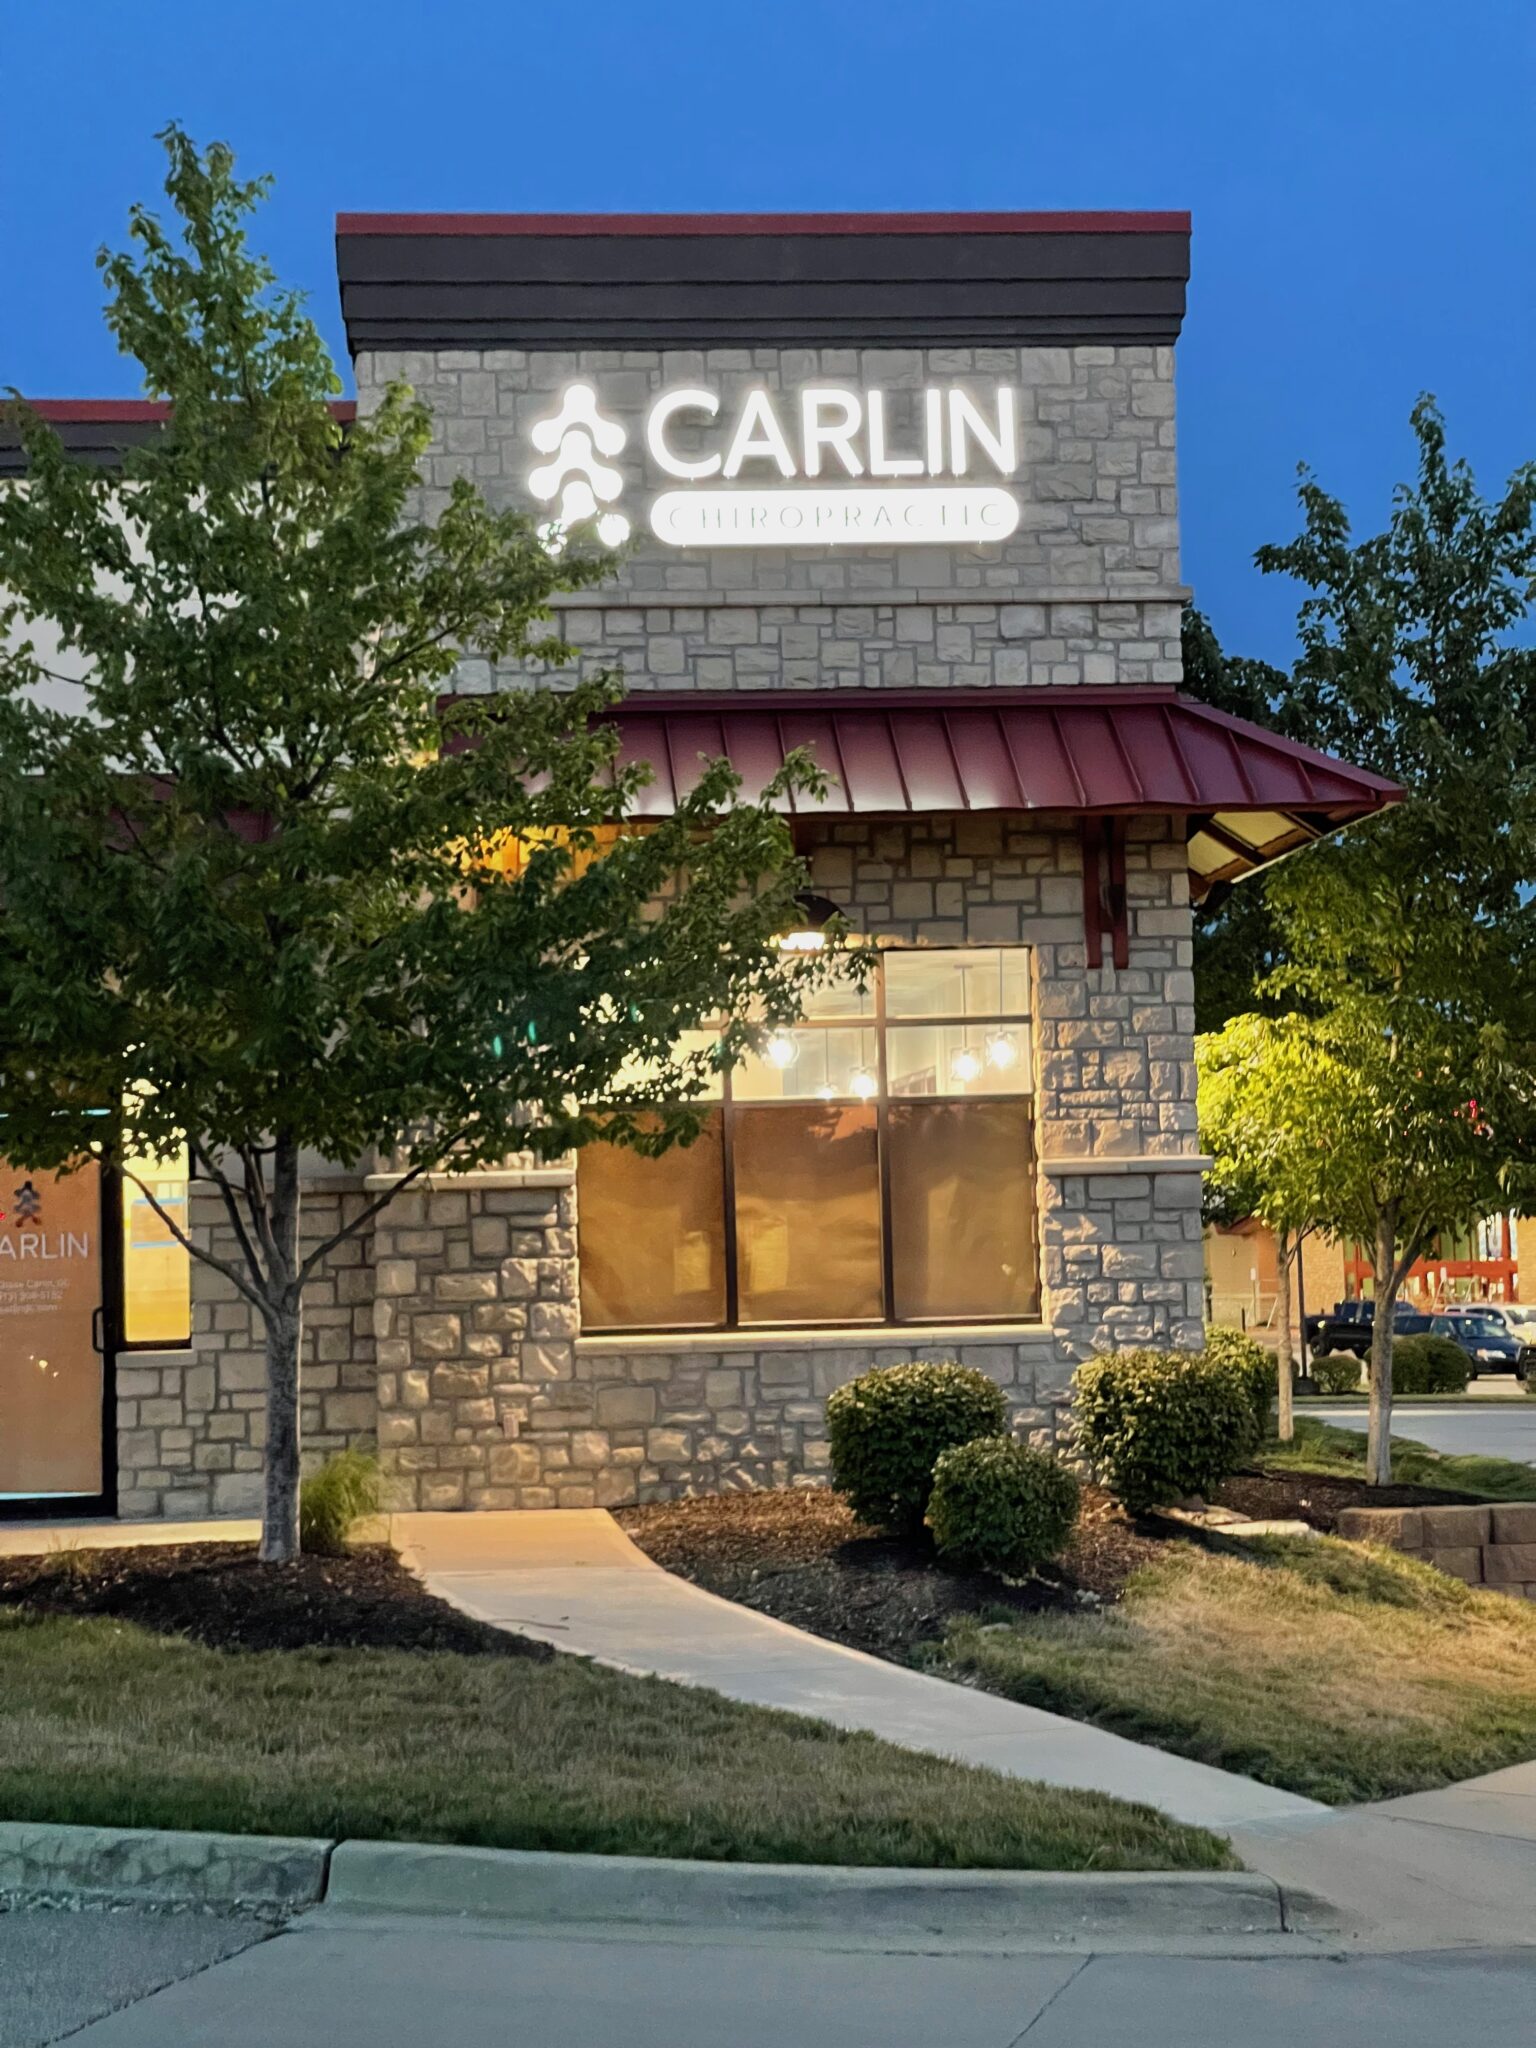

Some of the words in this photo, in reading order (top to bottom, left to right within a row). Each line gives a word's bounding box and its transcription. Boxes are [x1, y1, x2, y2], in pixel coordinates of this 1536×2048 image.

[647, 388, 1016, 478] CARLIN
[669, 503, 1003, 529] CHIROPRACTIC
[0, 1231, 89, 1260] ARLIN
